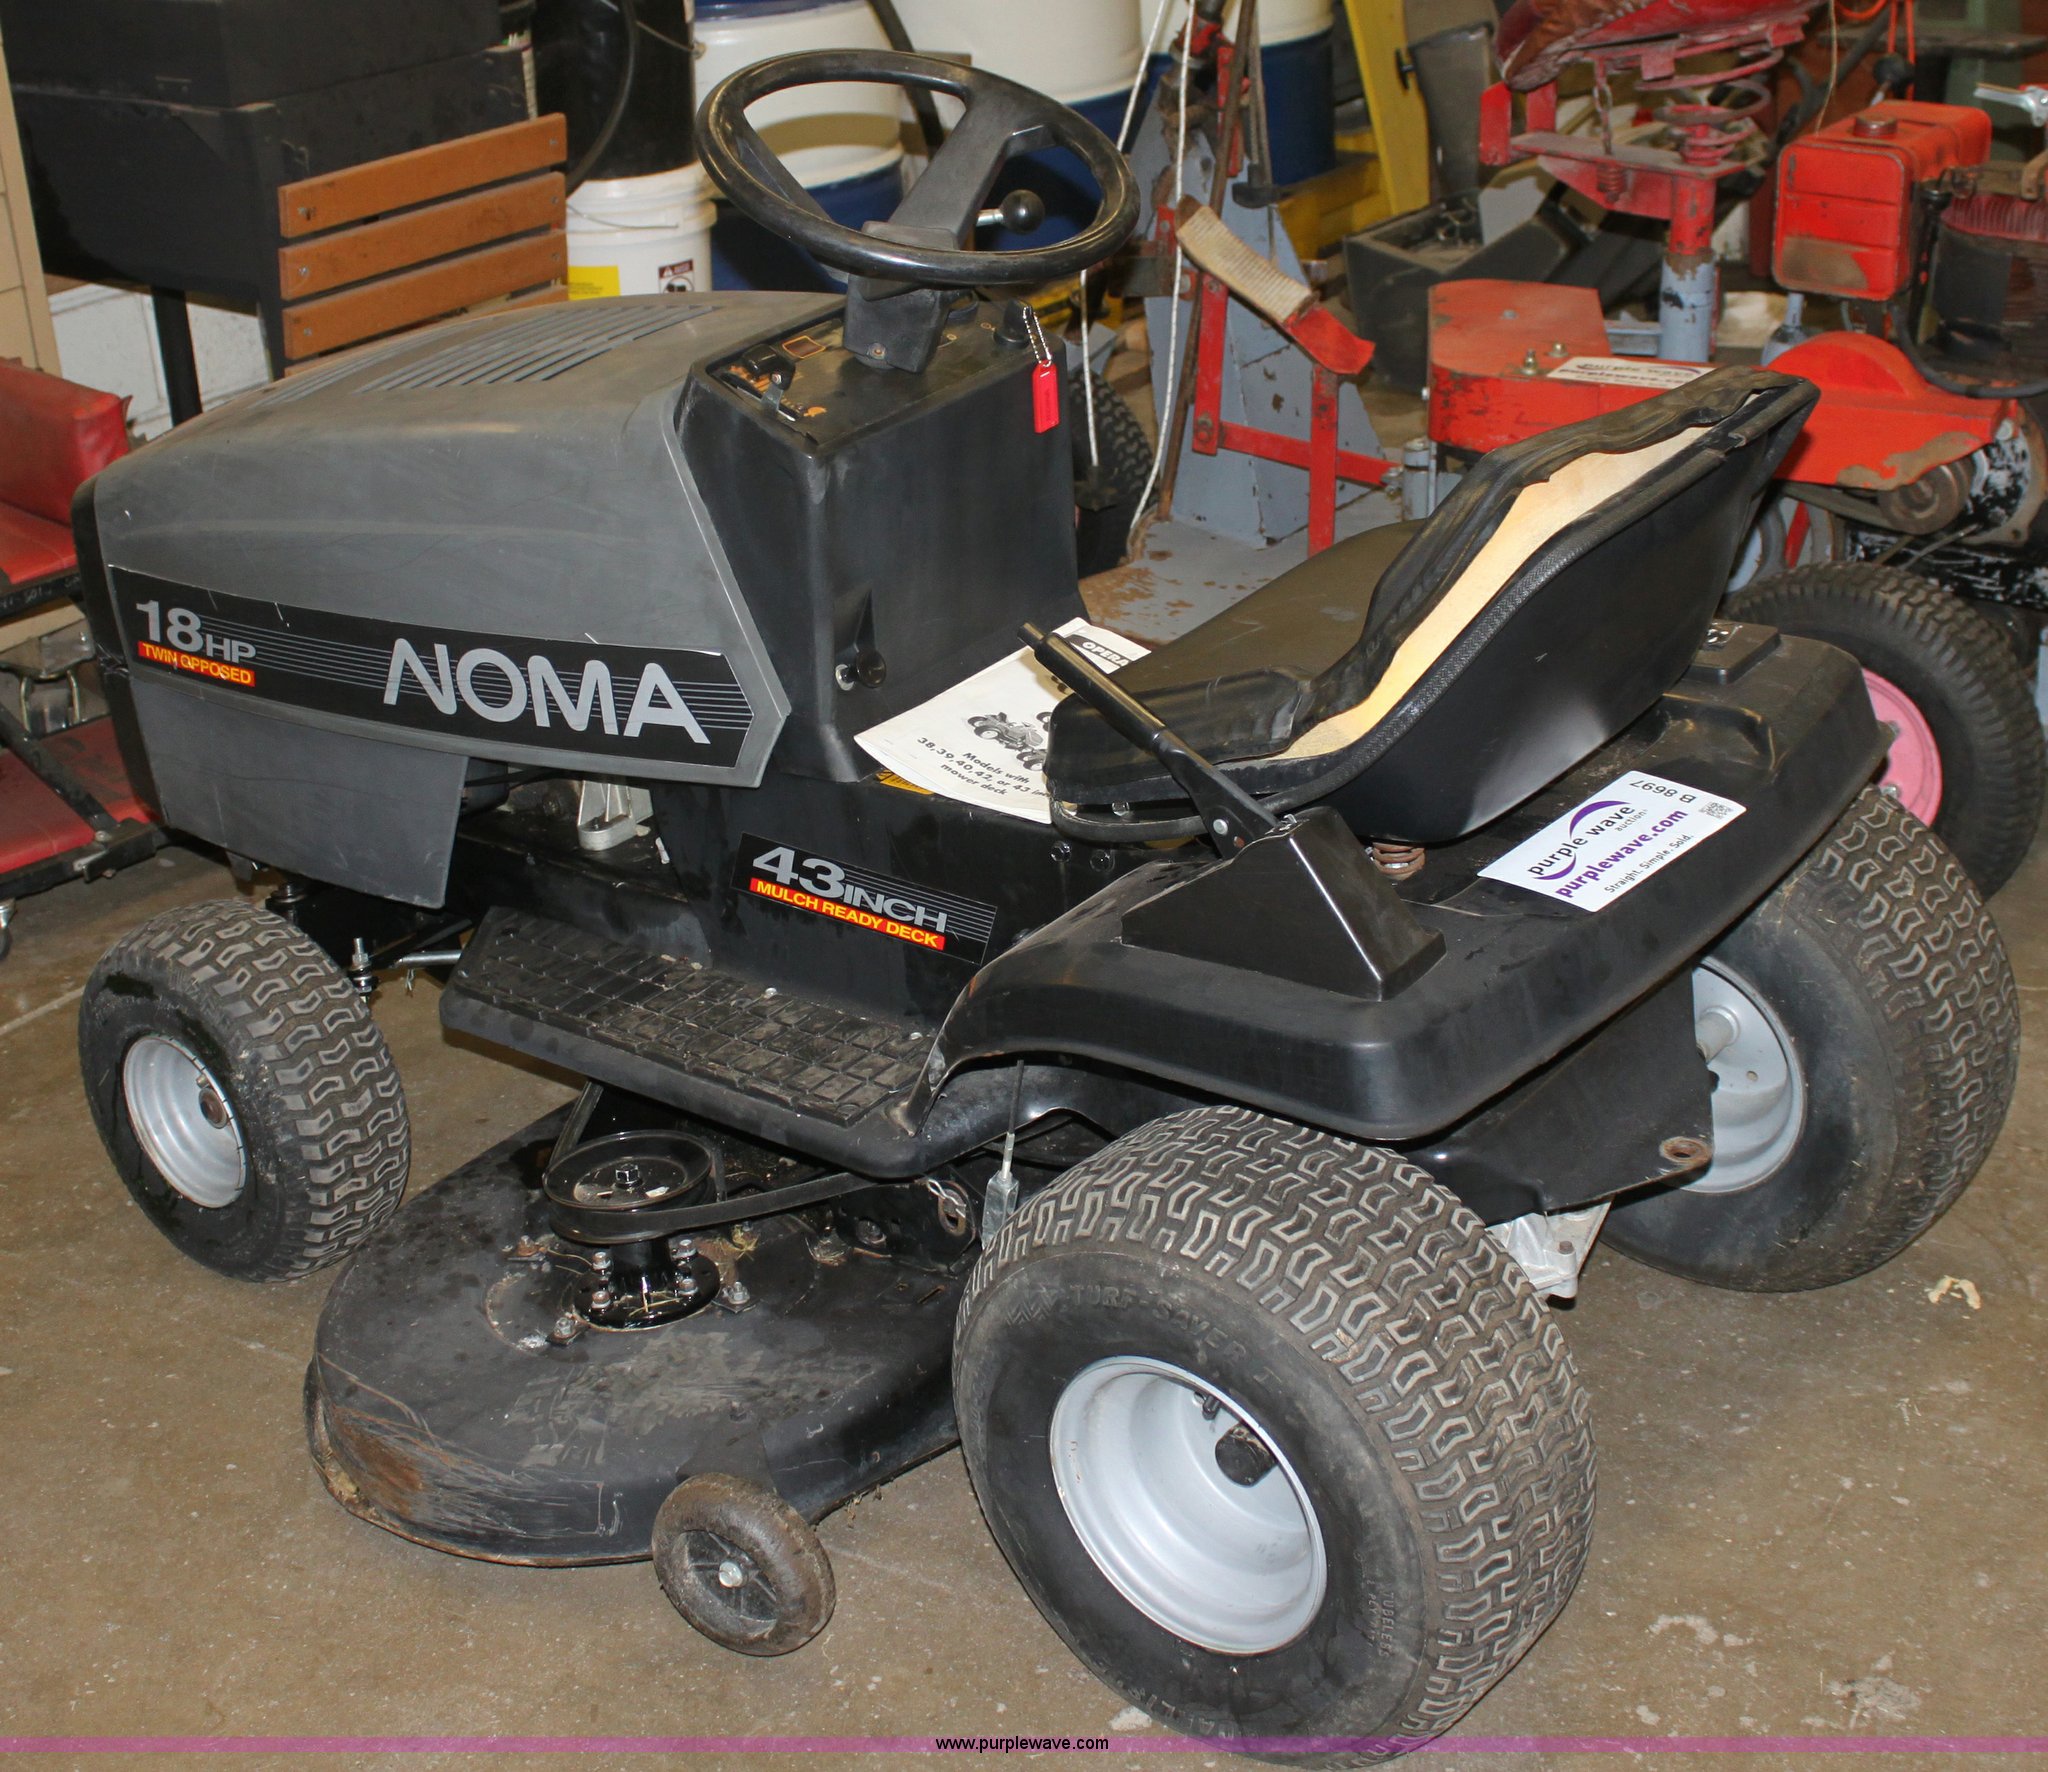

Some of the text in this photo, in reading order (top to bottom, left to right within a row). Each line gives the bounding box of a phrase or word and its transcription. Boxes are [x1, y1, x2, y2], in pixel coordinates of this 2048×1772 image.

[143, 643, 252, 684] TWIN OPPOSED
[383, 638, 711, 744] NOMA
[941, 764, 980, 785] mower
[980, 783, 1009, 796] deck
[962, 752, 1030, 784] Models with
[1527, 806, 1636, 876] purple wave
[1555, 810, 1689, 898] purplewave.com
[757, 880, 938, 948] MULCH READY DECK
